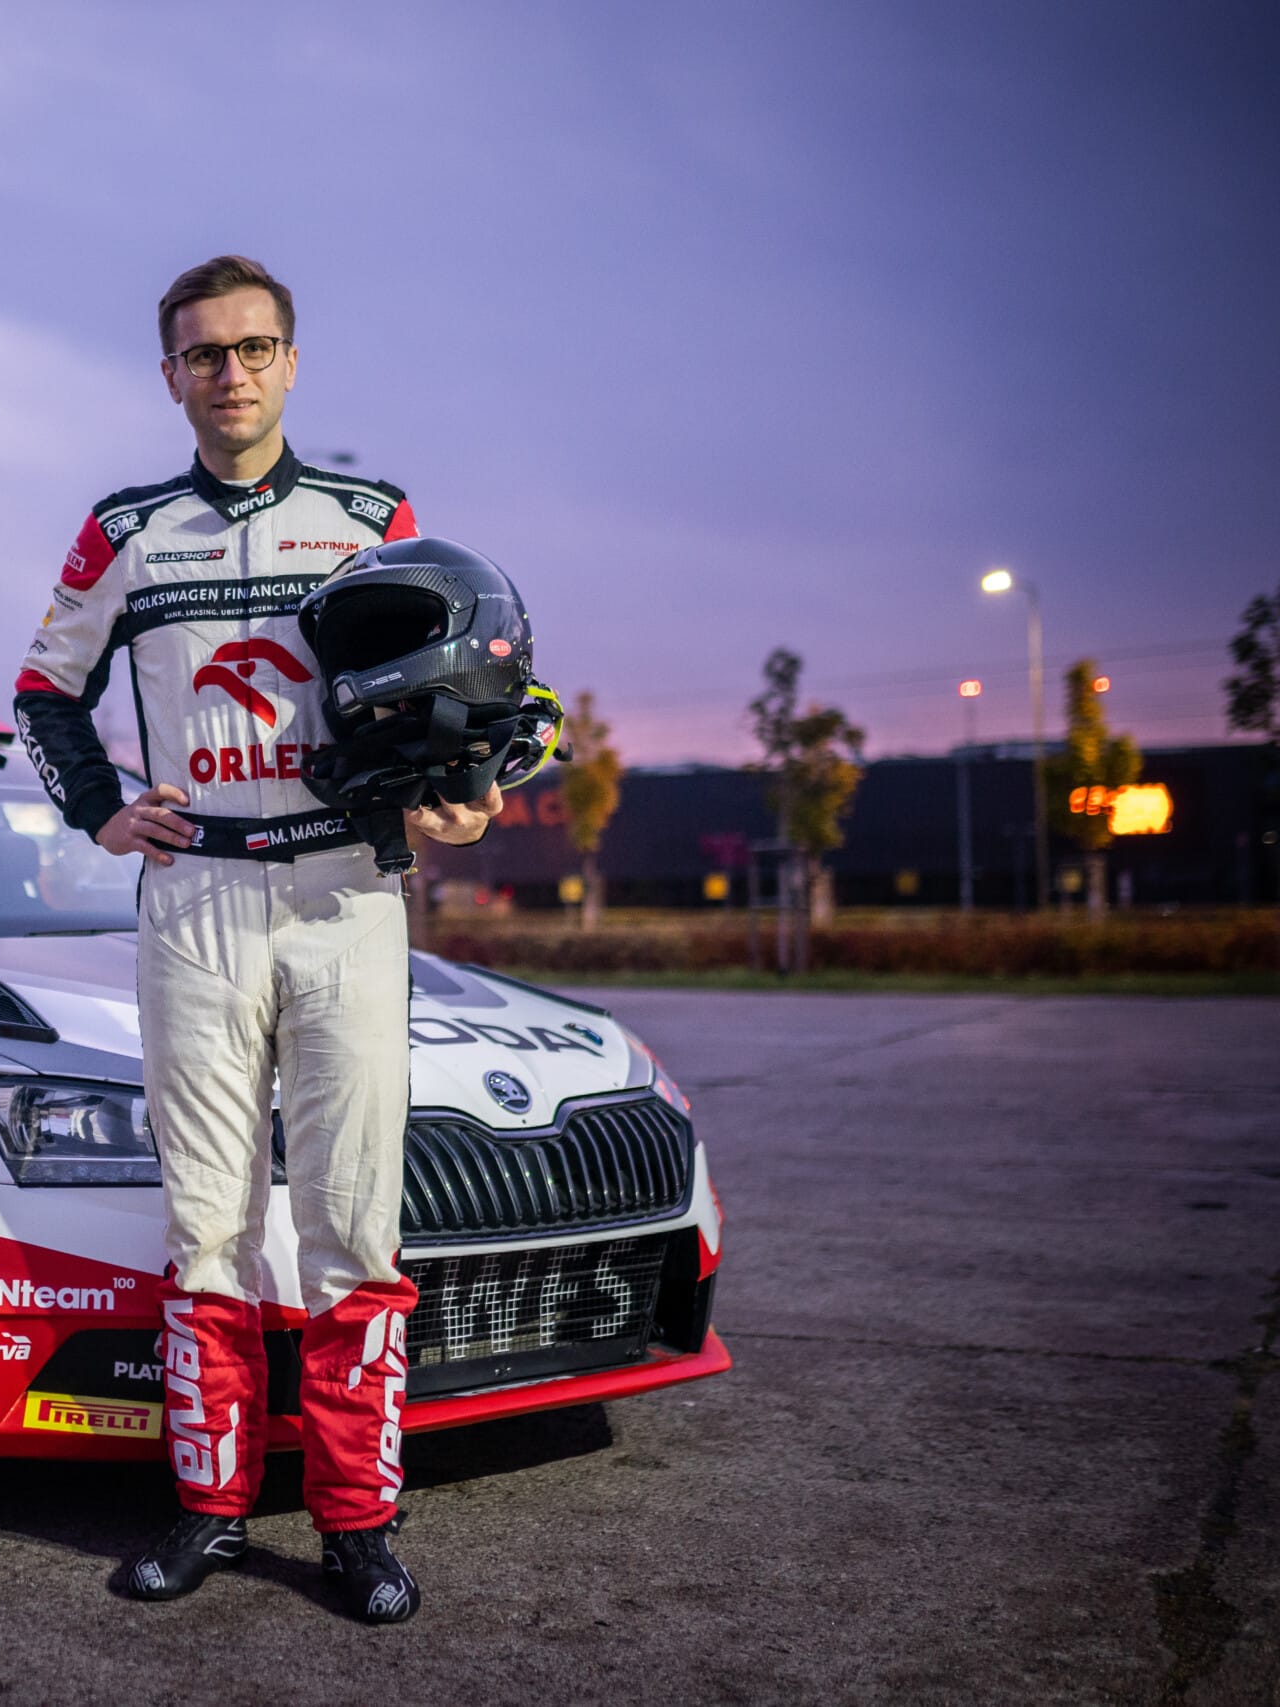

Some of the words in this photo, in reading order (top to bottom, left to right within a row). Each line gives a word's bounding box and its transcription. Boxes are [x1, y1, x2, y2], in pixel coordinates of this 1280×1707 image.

[228, 488, 276, 518] verva
[351, 500, 389, 521] OMP
[106, 514, 139, 539] OMP
[300, 541, 359, 551] PLATINUM
[130, 588, 219, 613] VOLKSWAGEN
[224, 583, 306, 600] FINANCIAL
[269, 830, 288, 846] M.
[113, 1277, 136, 1290] 100
[163, 1298, 214, 1487] verva
[376, 1311, 408, 1502] verva
[38, 1400, 151, 1431] PIRELLI
[142, 1562, 161, 1590] OMP
[371, 1583, 398, 1615] OMP
